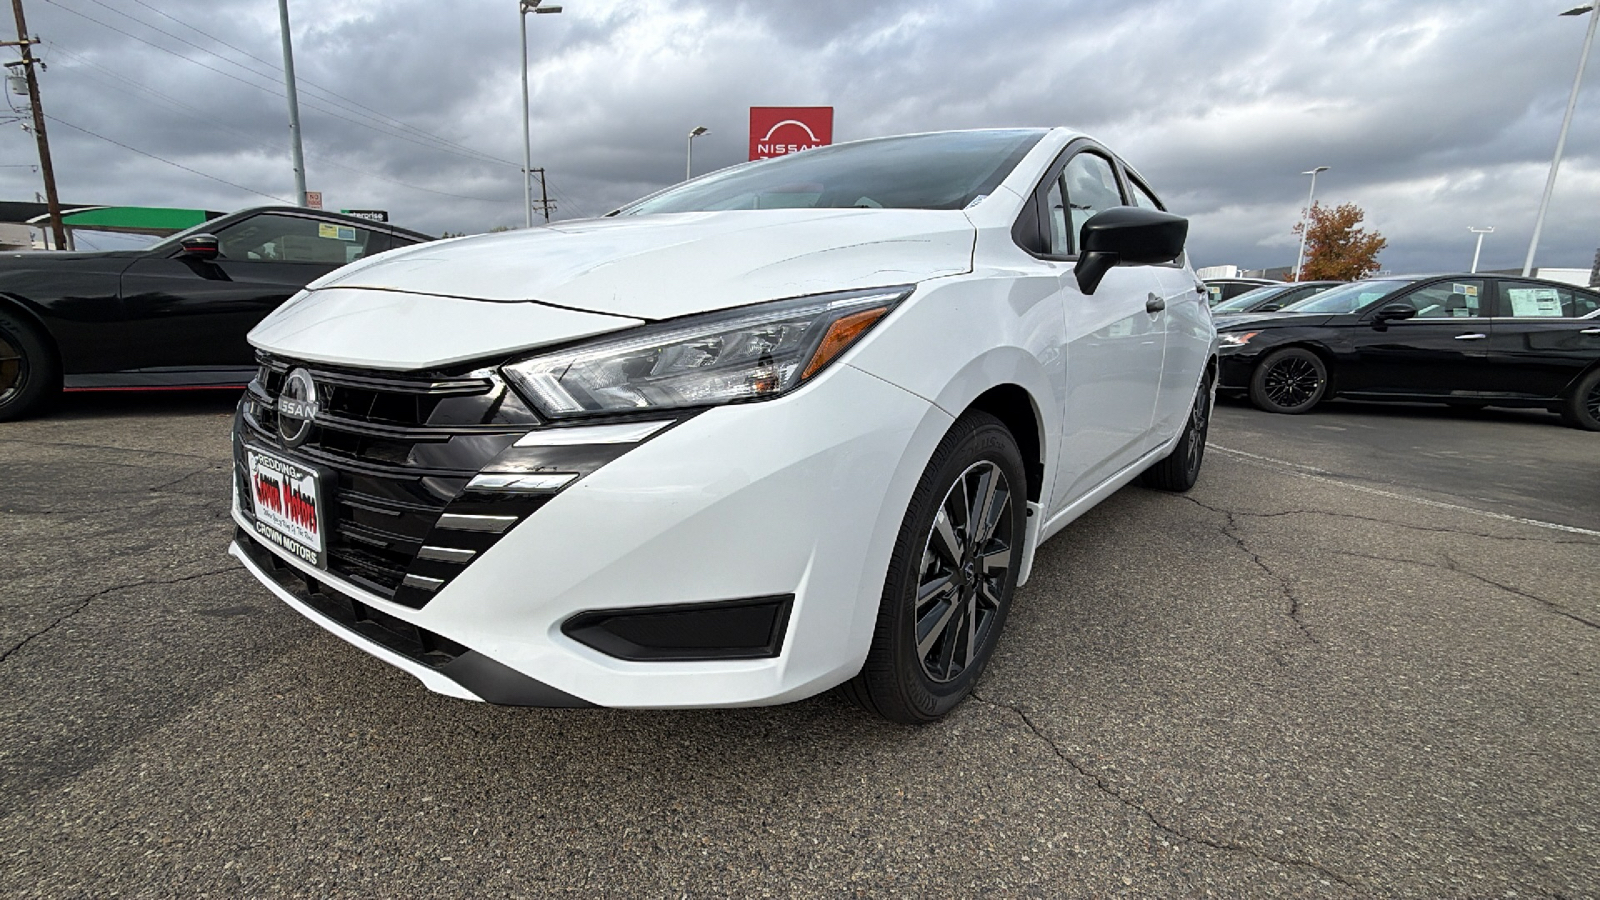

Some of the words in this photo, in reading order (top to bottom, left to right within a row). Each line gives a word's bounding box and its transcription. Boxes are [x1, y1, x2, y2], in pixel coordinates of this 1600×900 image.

[278, 400, 318, 420] SSAN
[256, 521, 283, 547] CROWN
[283, 536, 318, 565] MOTORS
